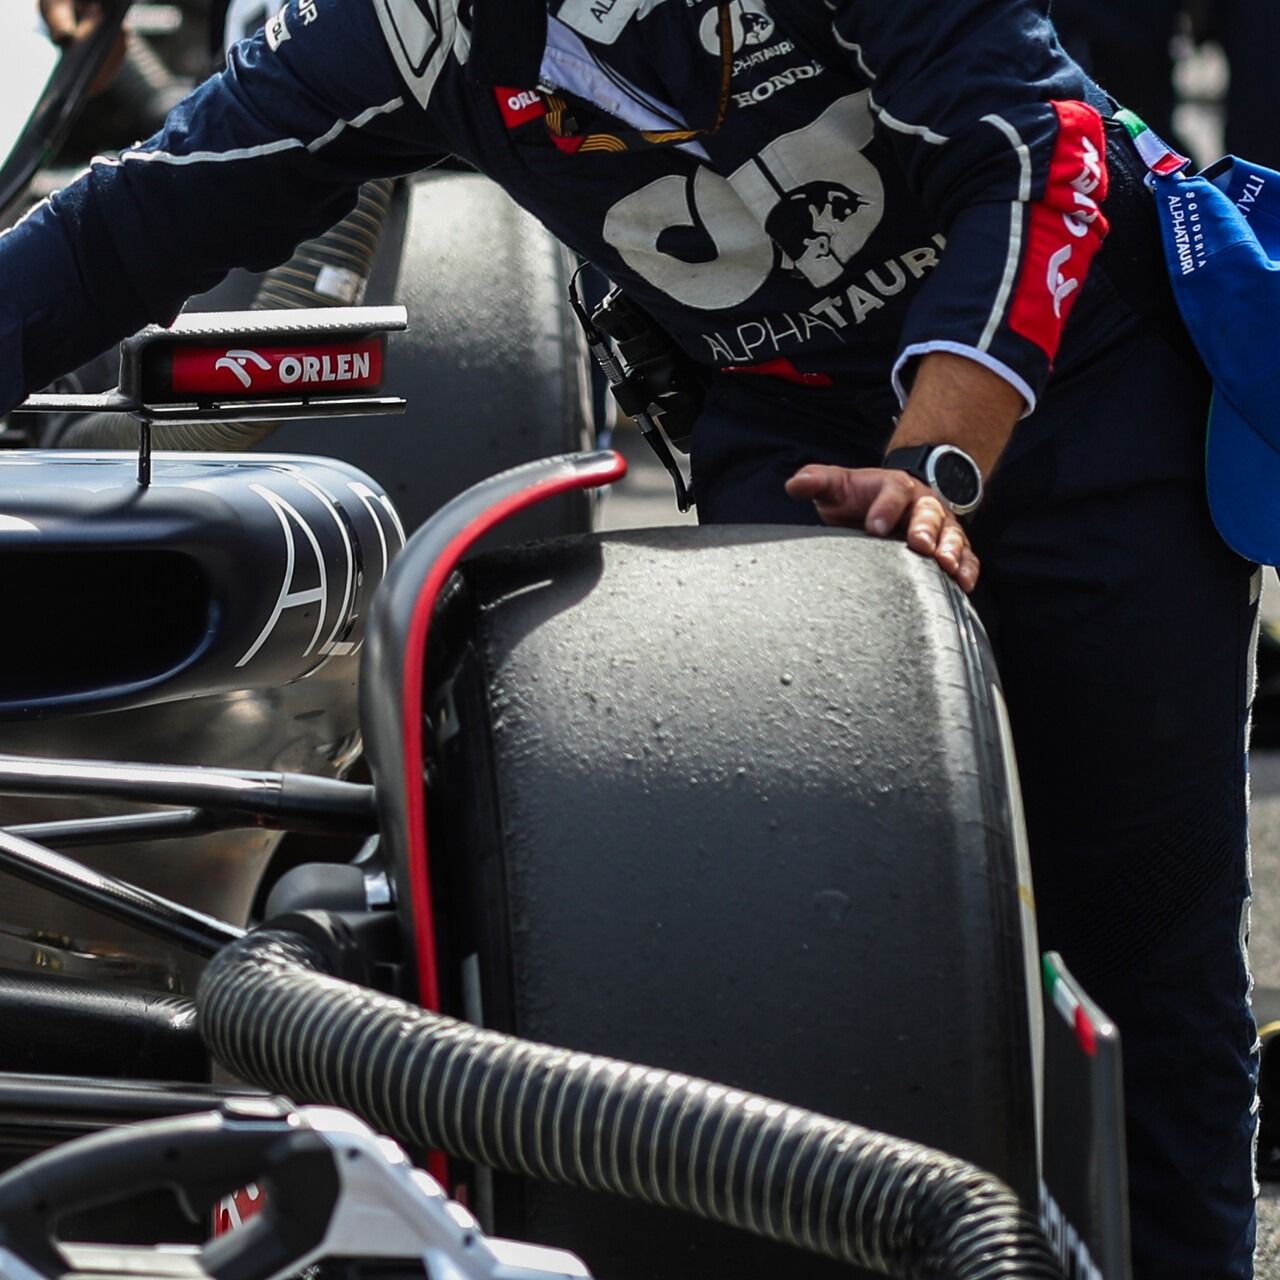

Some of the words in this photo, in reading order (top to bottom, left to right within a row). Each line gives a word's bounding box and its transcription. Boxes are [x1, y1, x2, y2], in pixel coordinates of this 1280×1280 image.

[507, 89, 541, 112] ORL
[1167, 194, 1196, 276] ALPHATAURI
[278, 352, 370, 384] ORLEN
